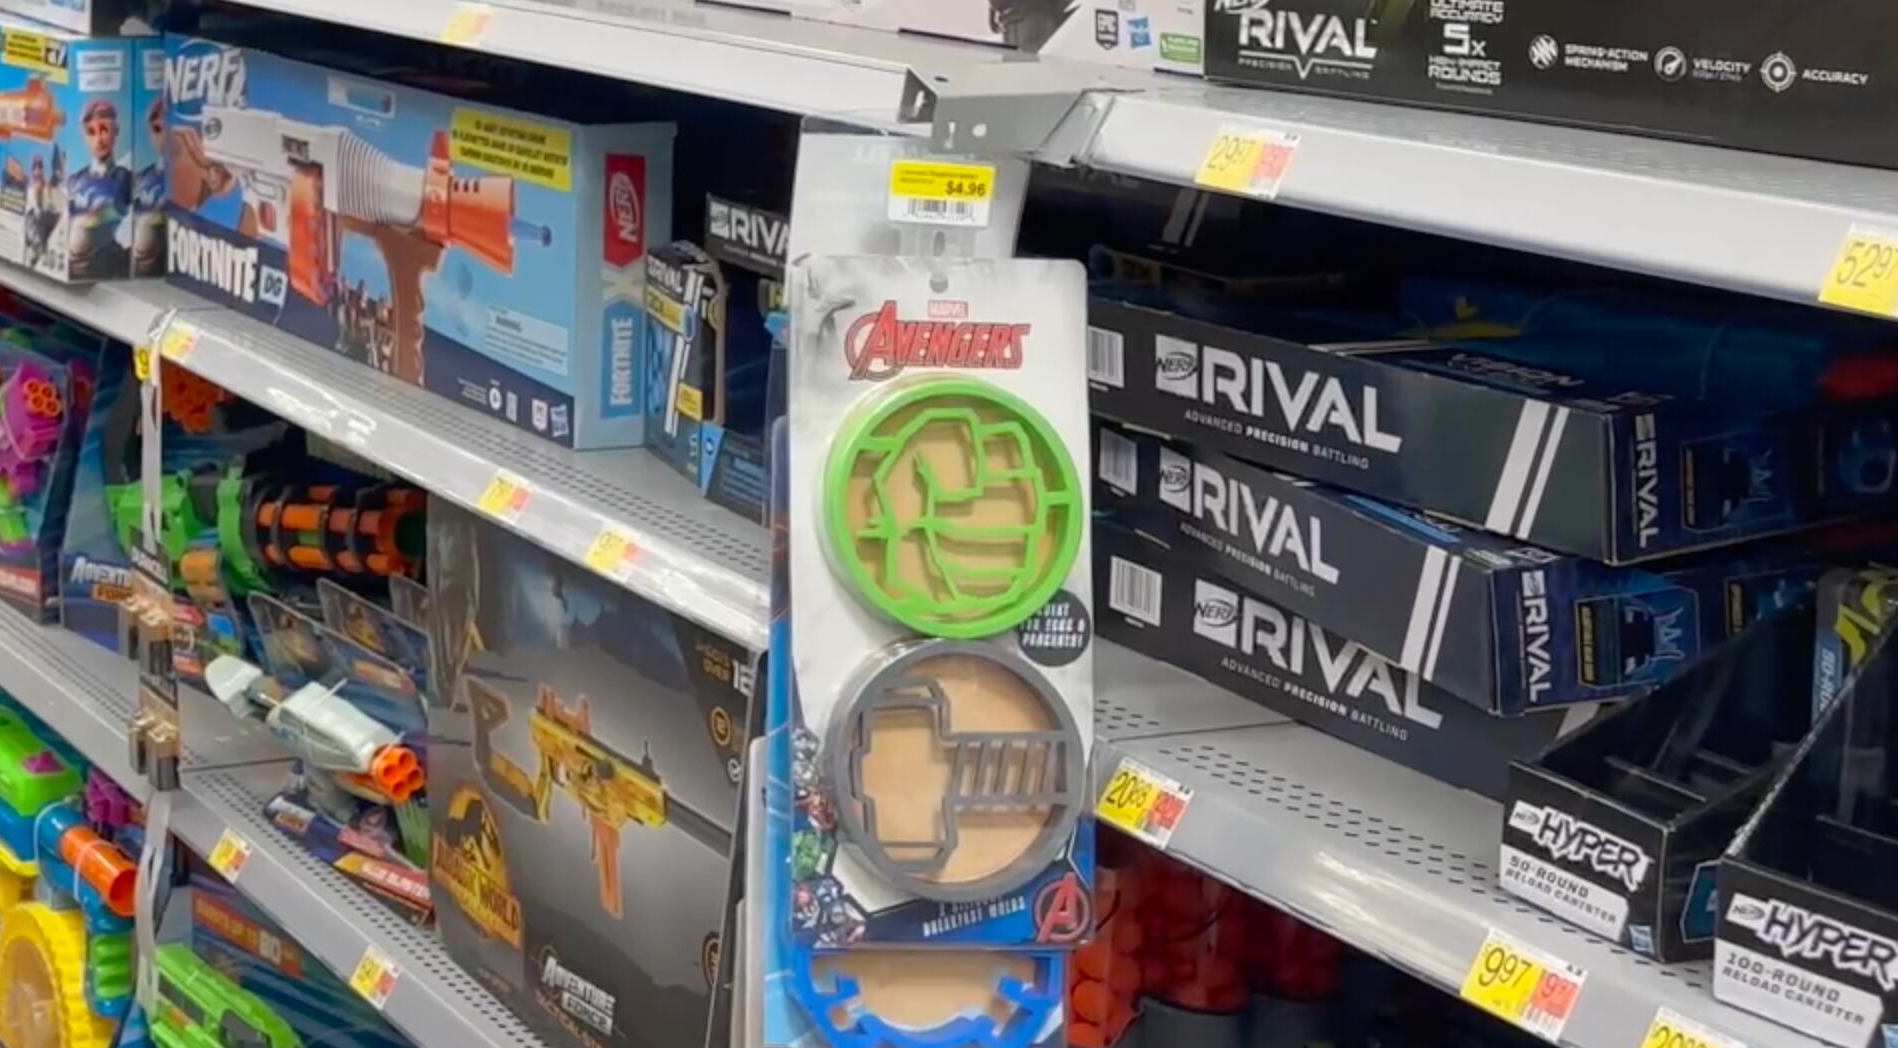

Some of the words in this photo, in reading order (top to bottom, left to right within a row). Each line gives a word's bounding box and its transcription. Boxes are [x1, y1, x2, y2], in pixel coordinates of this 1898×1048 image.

[1238, 9, 1377, 59] RIVAL
[1429, 8, 1503, 24] ACCURACY
[164, 48, 245, 107] NERF
[1428, 65, 1501, 85] ROUNDS
[1565, 56, 1628, 72] MECHANISM
[1693, 58, 1751, 74] VELOCITY
[1802, 69, 1869, 85] ACCURACY
[616, 174, 638, 242] NERF
[945, 181, 986, 197] $4.96
[168, 220, 259, 304] FORTNITE
[263, 271, 284, 296] DG
[610, 318, 633, 406] FORTNITE
[846, 300, 1031, 380] AVENGERS
[1156, 351, 1198, 381] NERF
[1202, 345, 1402, 453] RIVAL
[1184, 409, 1243, 434] ADVANCED
[1245, 426, 1308, 453] PRECISION
[1312, 443, 1370, 470] BATTLING
[1193, 461, 1340, 585] RIVAL
[1636, 440, 1659, 548] RIVAL
[1180, 522, 1223, 551] ADVANCED
[1225, 543, 1271, 577] PRECISION
[1273, 565, 1316, 598] BATTLING
[1195, 601, 1237, 627] NERF
[1240, 597, 1443, 729] RIVAL
[1523, 591, 1553, 702] RIVAL
[1221, 657, 1281, 688] ADVANCED
[1283, 682, 1347, 715] PRECISION
[1350, 708, 1408, 742] BATTLING
[1508, 856, 1589, 899] 50-ROUND
[1537, 807, 1654, 892] HYPER
[1506, 868, 1552, 897] RELOAD
[1553, 888, 1616, 925] CANISTER
[1726, 952, 1840, 1003] 100-ROUND
[1761, 900, 1898, 991] HYPER
[1721, 966, 1782, 997] RELOAD
[1785, 988, 1865, 1026] CANISTER
